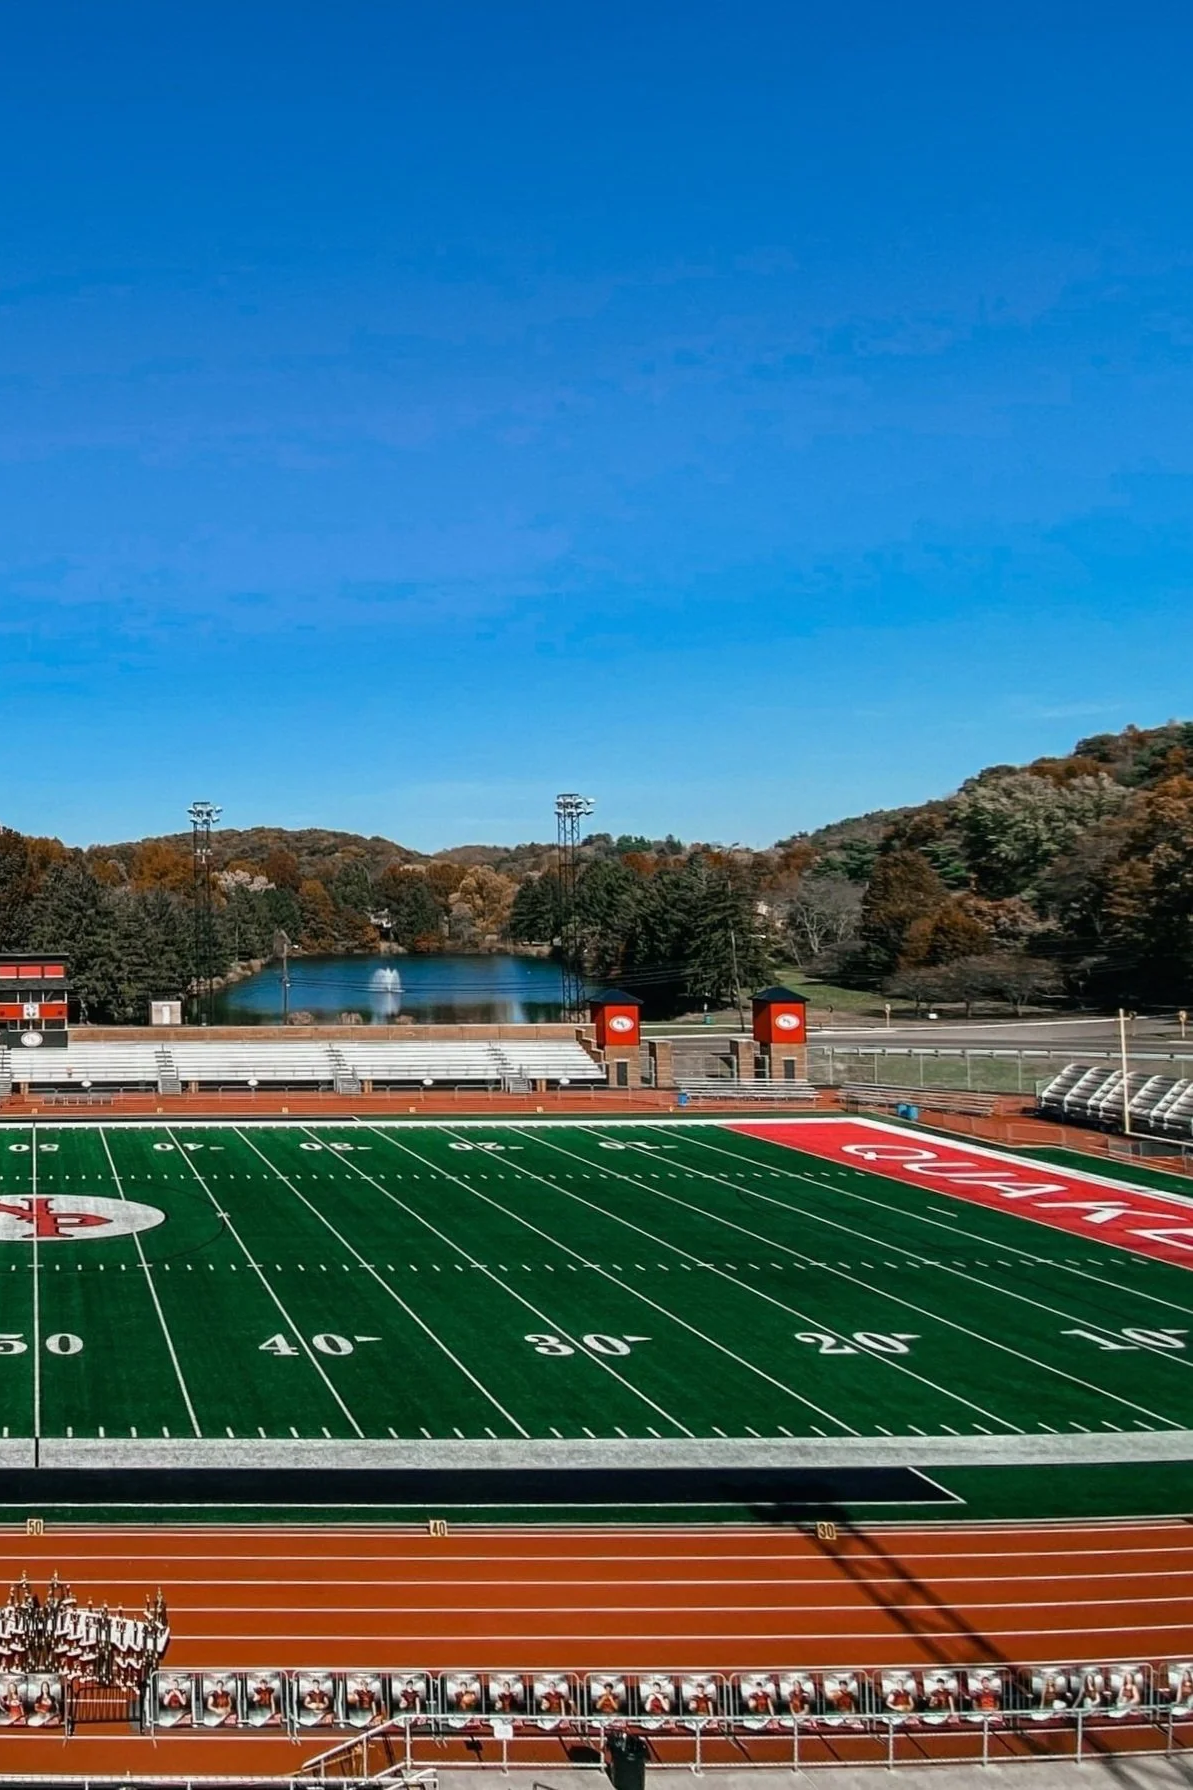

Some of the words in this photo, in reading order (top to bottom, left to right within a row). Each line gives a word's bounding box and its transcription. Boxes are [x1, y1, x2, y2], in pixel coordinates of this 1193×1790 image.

[8, 1143, 60, 1152] 50
[152, 1142, 205, 1151] 40
[299, 1142, 355, 1151] 30
[447, 1141, 506, 1151] 20
[598, 1141, 661, 1150] 10
[258, 1332, 354, 1357] 40
[524, 1333, 631, 1357] 30
[793, 1331, 910, 1355] 20
[1059, 1328, 1186, 1350] 10
[28, 1520, 42, 1536] 50
[432, 1520, 447, 1537] 40
[818, 1523, 834, 1539] 30
